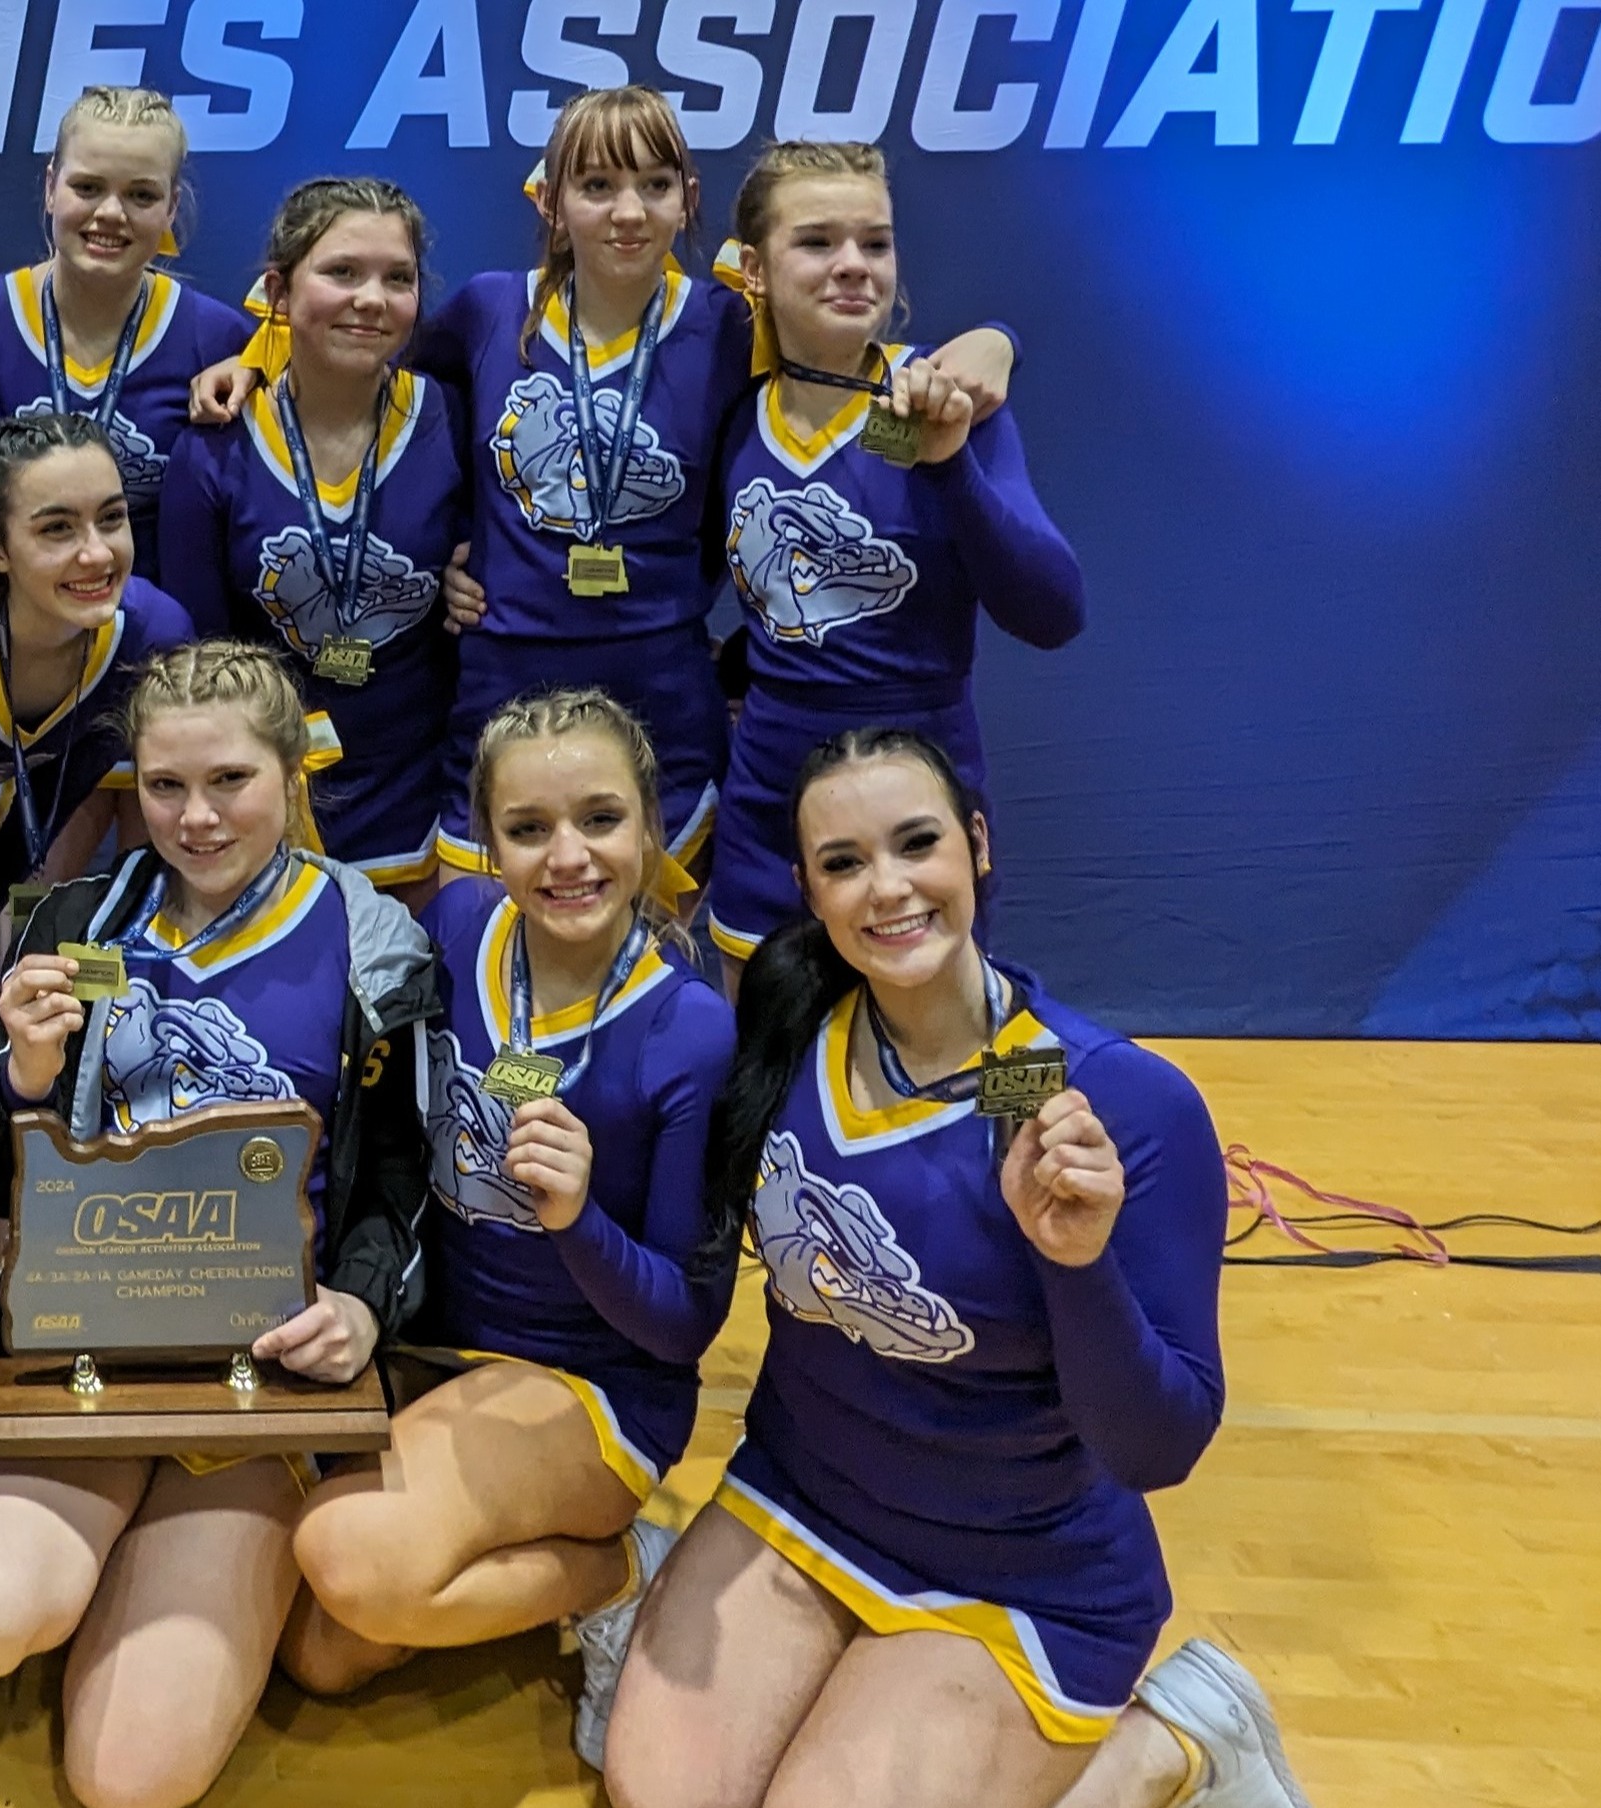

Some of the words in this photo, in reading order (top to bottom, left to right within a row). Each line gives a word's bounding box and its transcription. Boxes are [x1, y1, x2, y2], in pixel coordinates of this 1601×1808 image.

[345, 0, 1601, 151] ASSOCIATIO
[489, 1060, 558, 1096] OSAA
[983, 1066, 1064, 1098] OSAA
[36, 1180, 75, 1193] 2024
[74, 1191, 237, 1245] OSAA
[99, 1245, 136, 1255] SCHOOL
[140, 1243, 193, 1254] ACTIVITIES
[197, 1242, 261, 1253] ASSOCIATION
[117, 1268, 184, 1282] GAMEDAY
[189, 1265, 296, 1280] CHEERLEADING
[116, 1284, 205, 1299] CHAMPION
